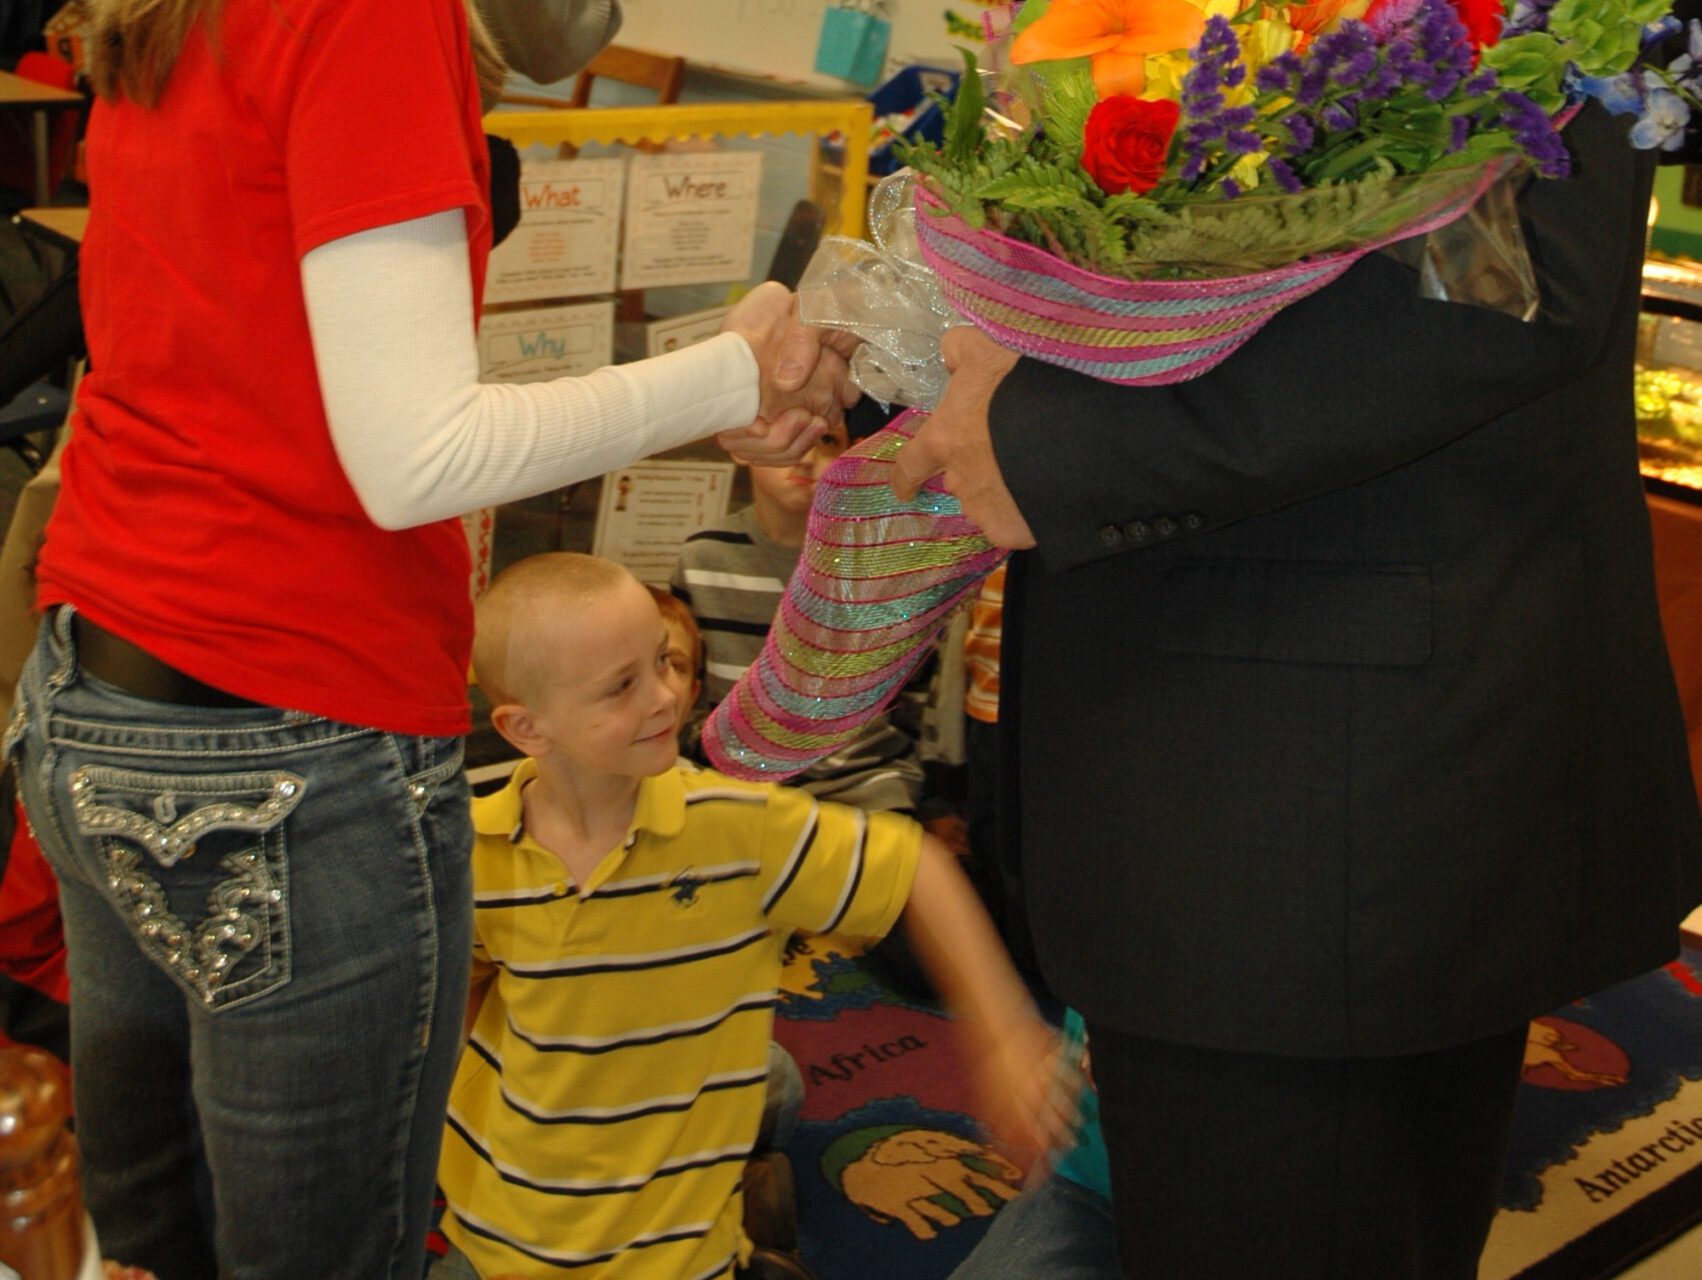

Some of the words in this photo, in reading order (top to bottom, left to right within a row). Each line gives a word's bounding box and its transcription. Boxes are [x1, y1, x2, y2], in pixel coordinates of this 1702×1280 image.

[522, 183, 582, 209] What
[663, 174, 728, 199] Where
[518, 329, 567, 360] Why
[807, 1034, 929, 1086] Africa
